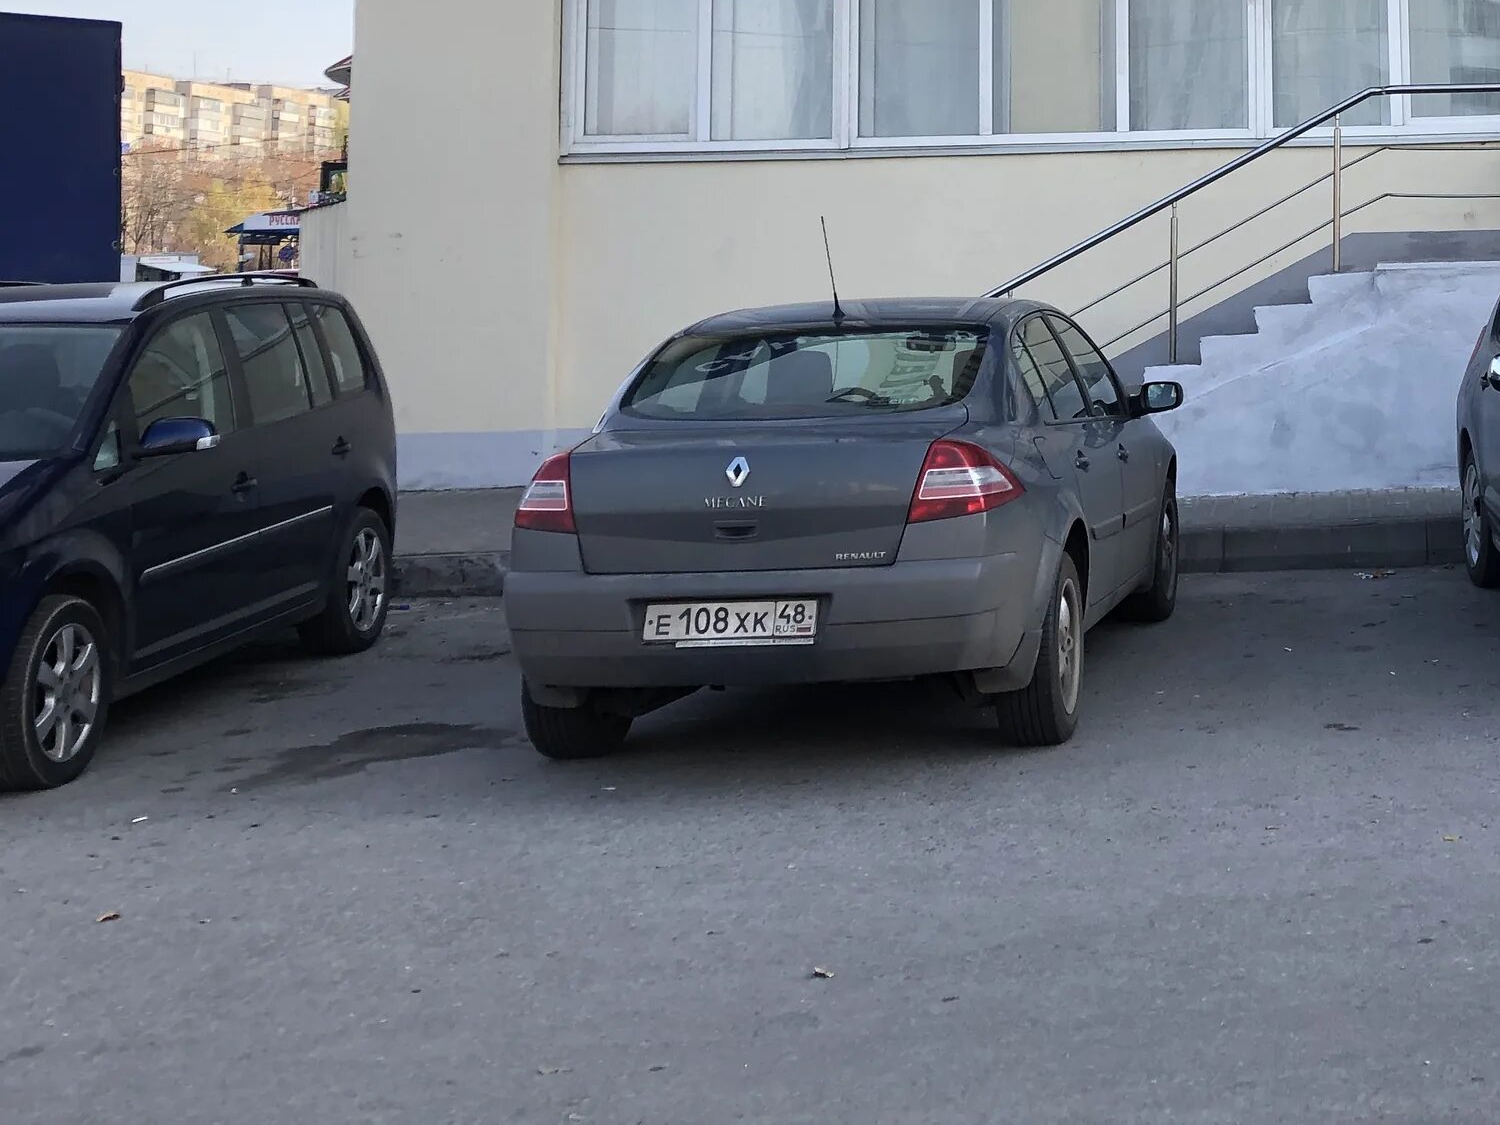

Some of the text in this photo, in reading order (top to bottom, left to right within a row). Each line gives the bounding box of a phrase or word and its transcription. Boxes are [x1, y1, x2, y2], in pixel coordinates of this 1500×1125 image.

[835, 550, 887, 561] RENAULT
[778, 603, 806, 625] 48
[775, 624, 796, 634] RUS
